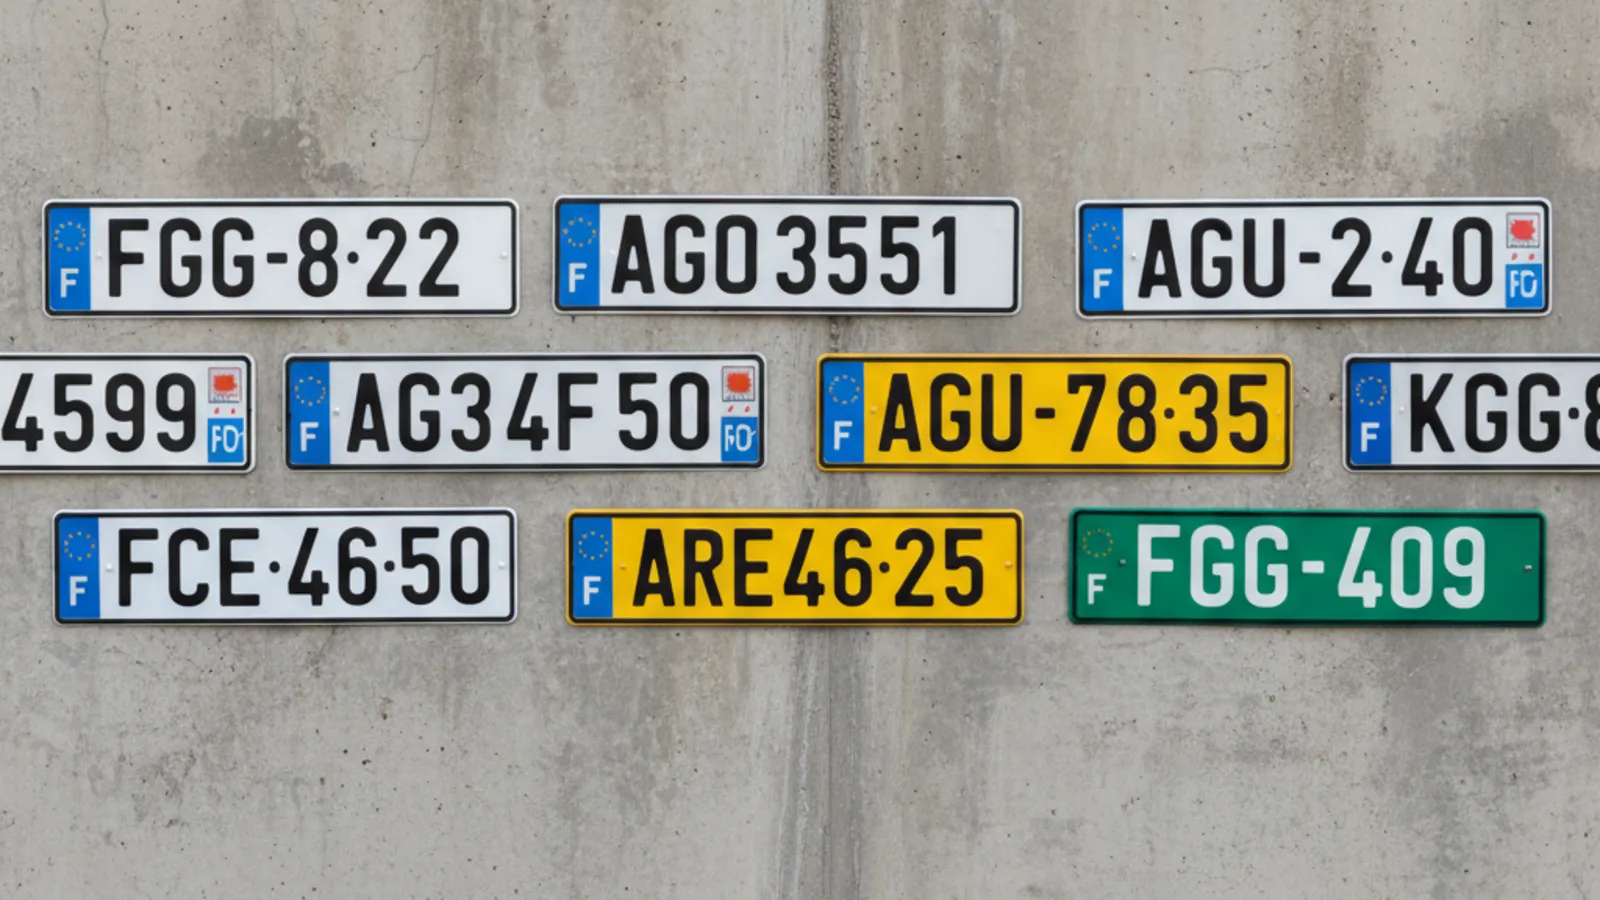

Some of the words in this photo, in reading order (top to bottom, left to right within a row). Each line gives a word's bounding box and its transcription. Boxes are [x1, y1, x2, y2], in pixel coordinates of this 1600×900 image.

[60, 269, 79, 298] F
[568, 263, 587, 293] F
[1093, 269, 1113, 299] F
[1, 373, 196, 453] 4599
[300, 422, 319, 452] F
[833, 420, 853, 451] F
[1361, 422, 1380, 452] F
[1137, 524, 1485, 609] FGG-409
[69, 576, 88, 606] F
[583, 576, 601, 605] F
[1088, 574, 1107, 605] F
